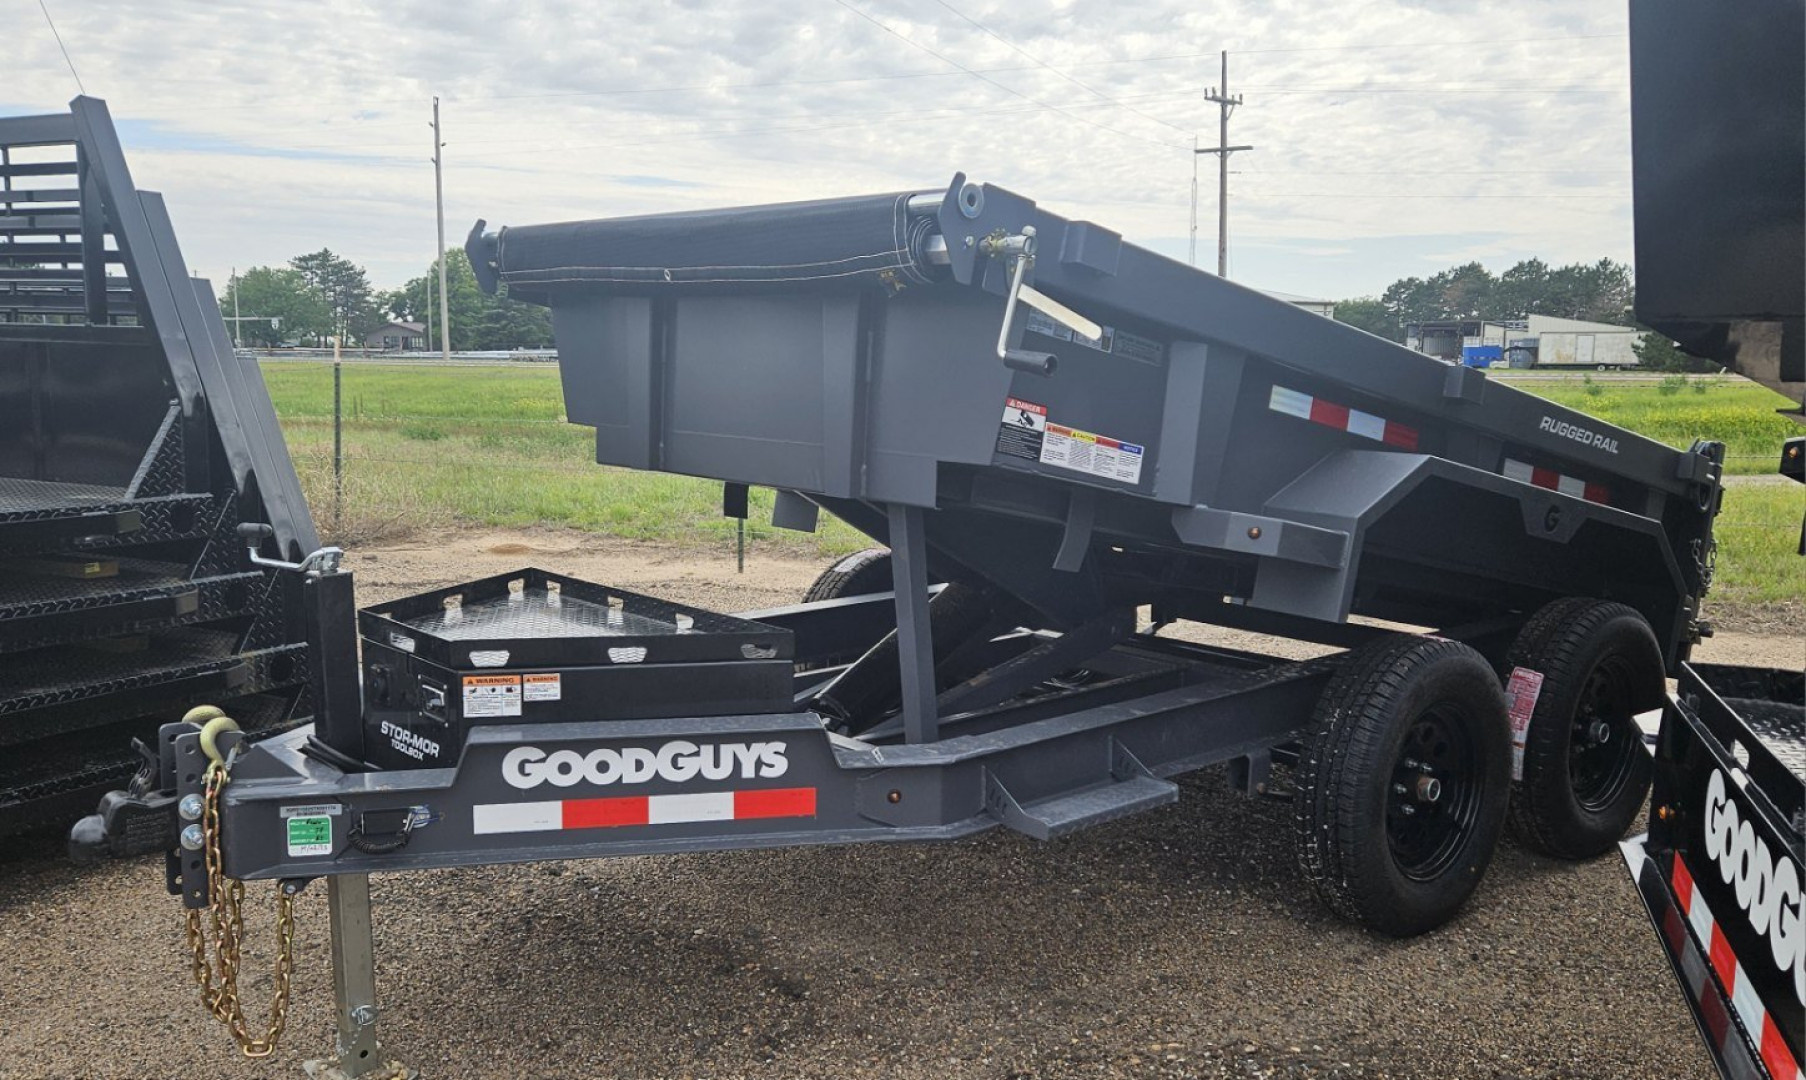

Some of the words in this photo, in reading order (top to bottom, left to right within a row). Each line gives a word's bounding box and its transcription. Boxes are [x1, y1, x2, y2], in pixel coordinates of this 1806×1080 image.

[1015, 400, 1041, 414] DANGER
[1076, 432, 1095, 442] CAUTION
[1540, 416, 1594, 444] RUGGED
[1592, 433, 1619, 454] RAIL
[381, 720, 440, 758] STOR-MOR
[391, 738, 424, 761] TOOLBOX
[502, 740, 789, 789] GOODGUYS
